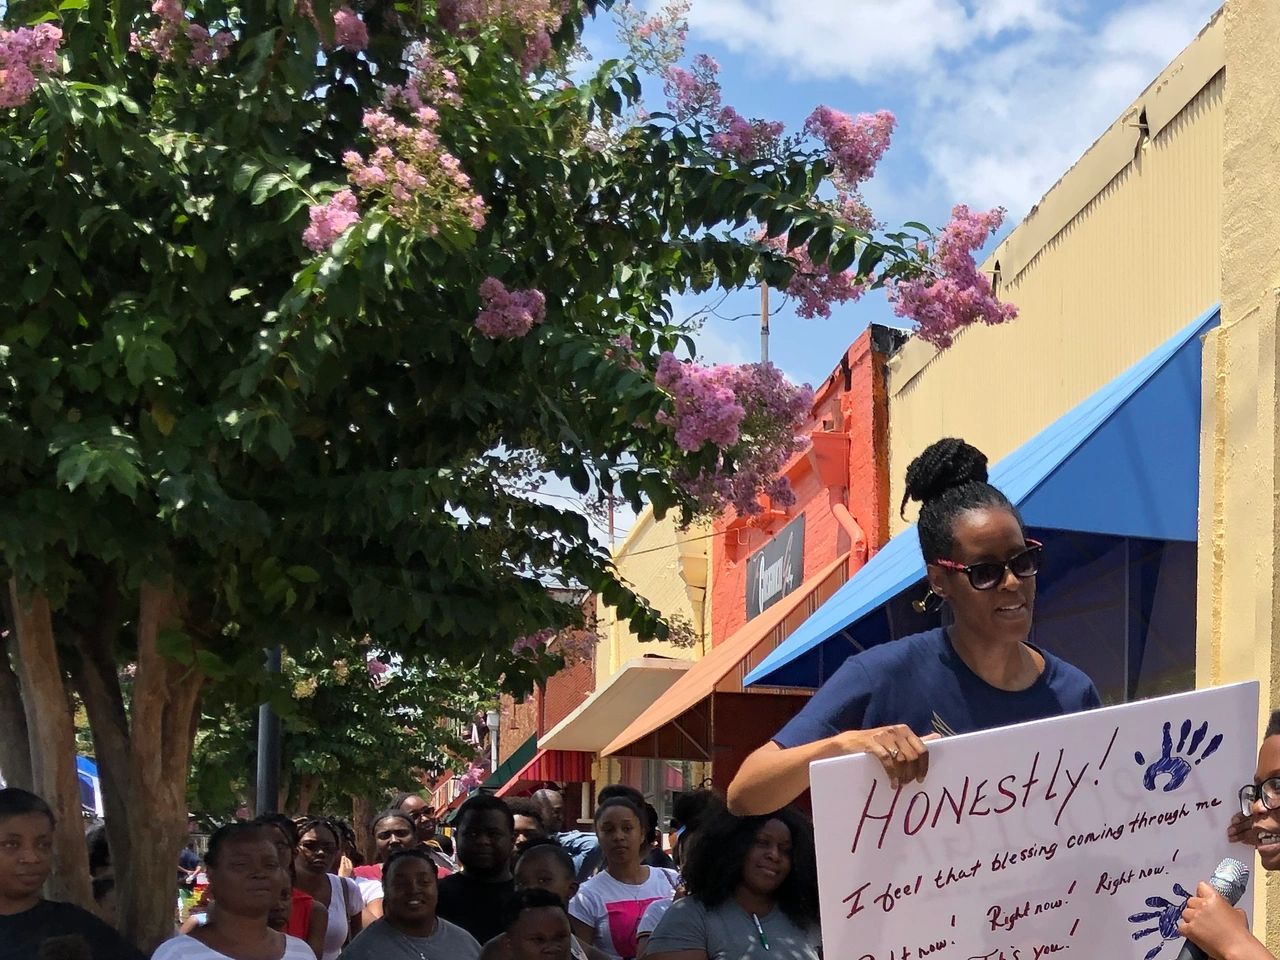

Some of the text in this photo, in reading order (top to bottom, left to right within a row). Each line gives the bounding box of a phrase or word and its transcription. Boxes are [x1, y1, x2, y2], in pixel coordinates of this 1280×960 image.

[842, 882, 871, 919] I
[873, 875, 923, 913] feel
[934, 859, 982, 888] that
[992, 842, 1058, 872] blessing
[1066, 823, 1125, 849] coming
[1128, 804, 1190, 834] through
[1195, 797, 1222, 811] me
[918, 914, 956, 959] now!
[986, 900, 1031, 931] Right
[1034, 880, 1077, 915] now!
[1094, 870, 1136, 896] Right
[1138, 848, 1180, 880] now!
